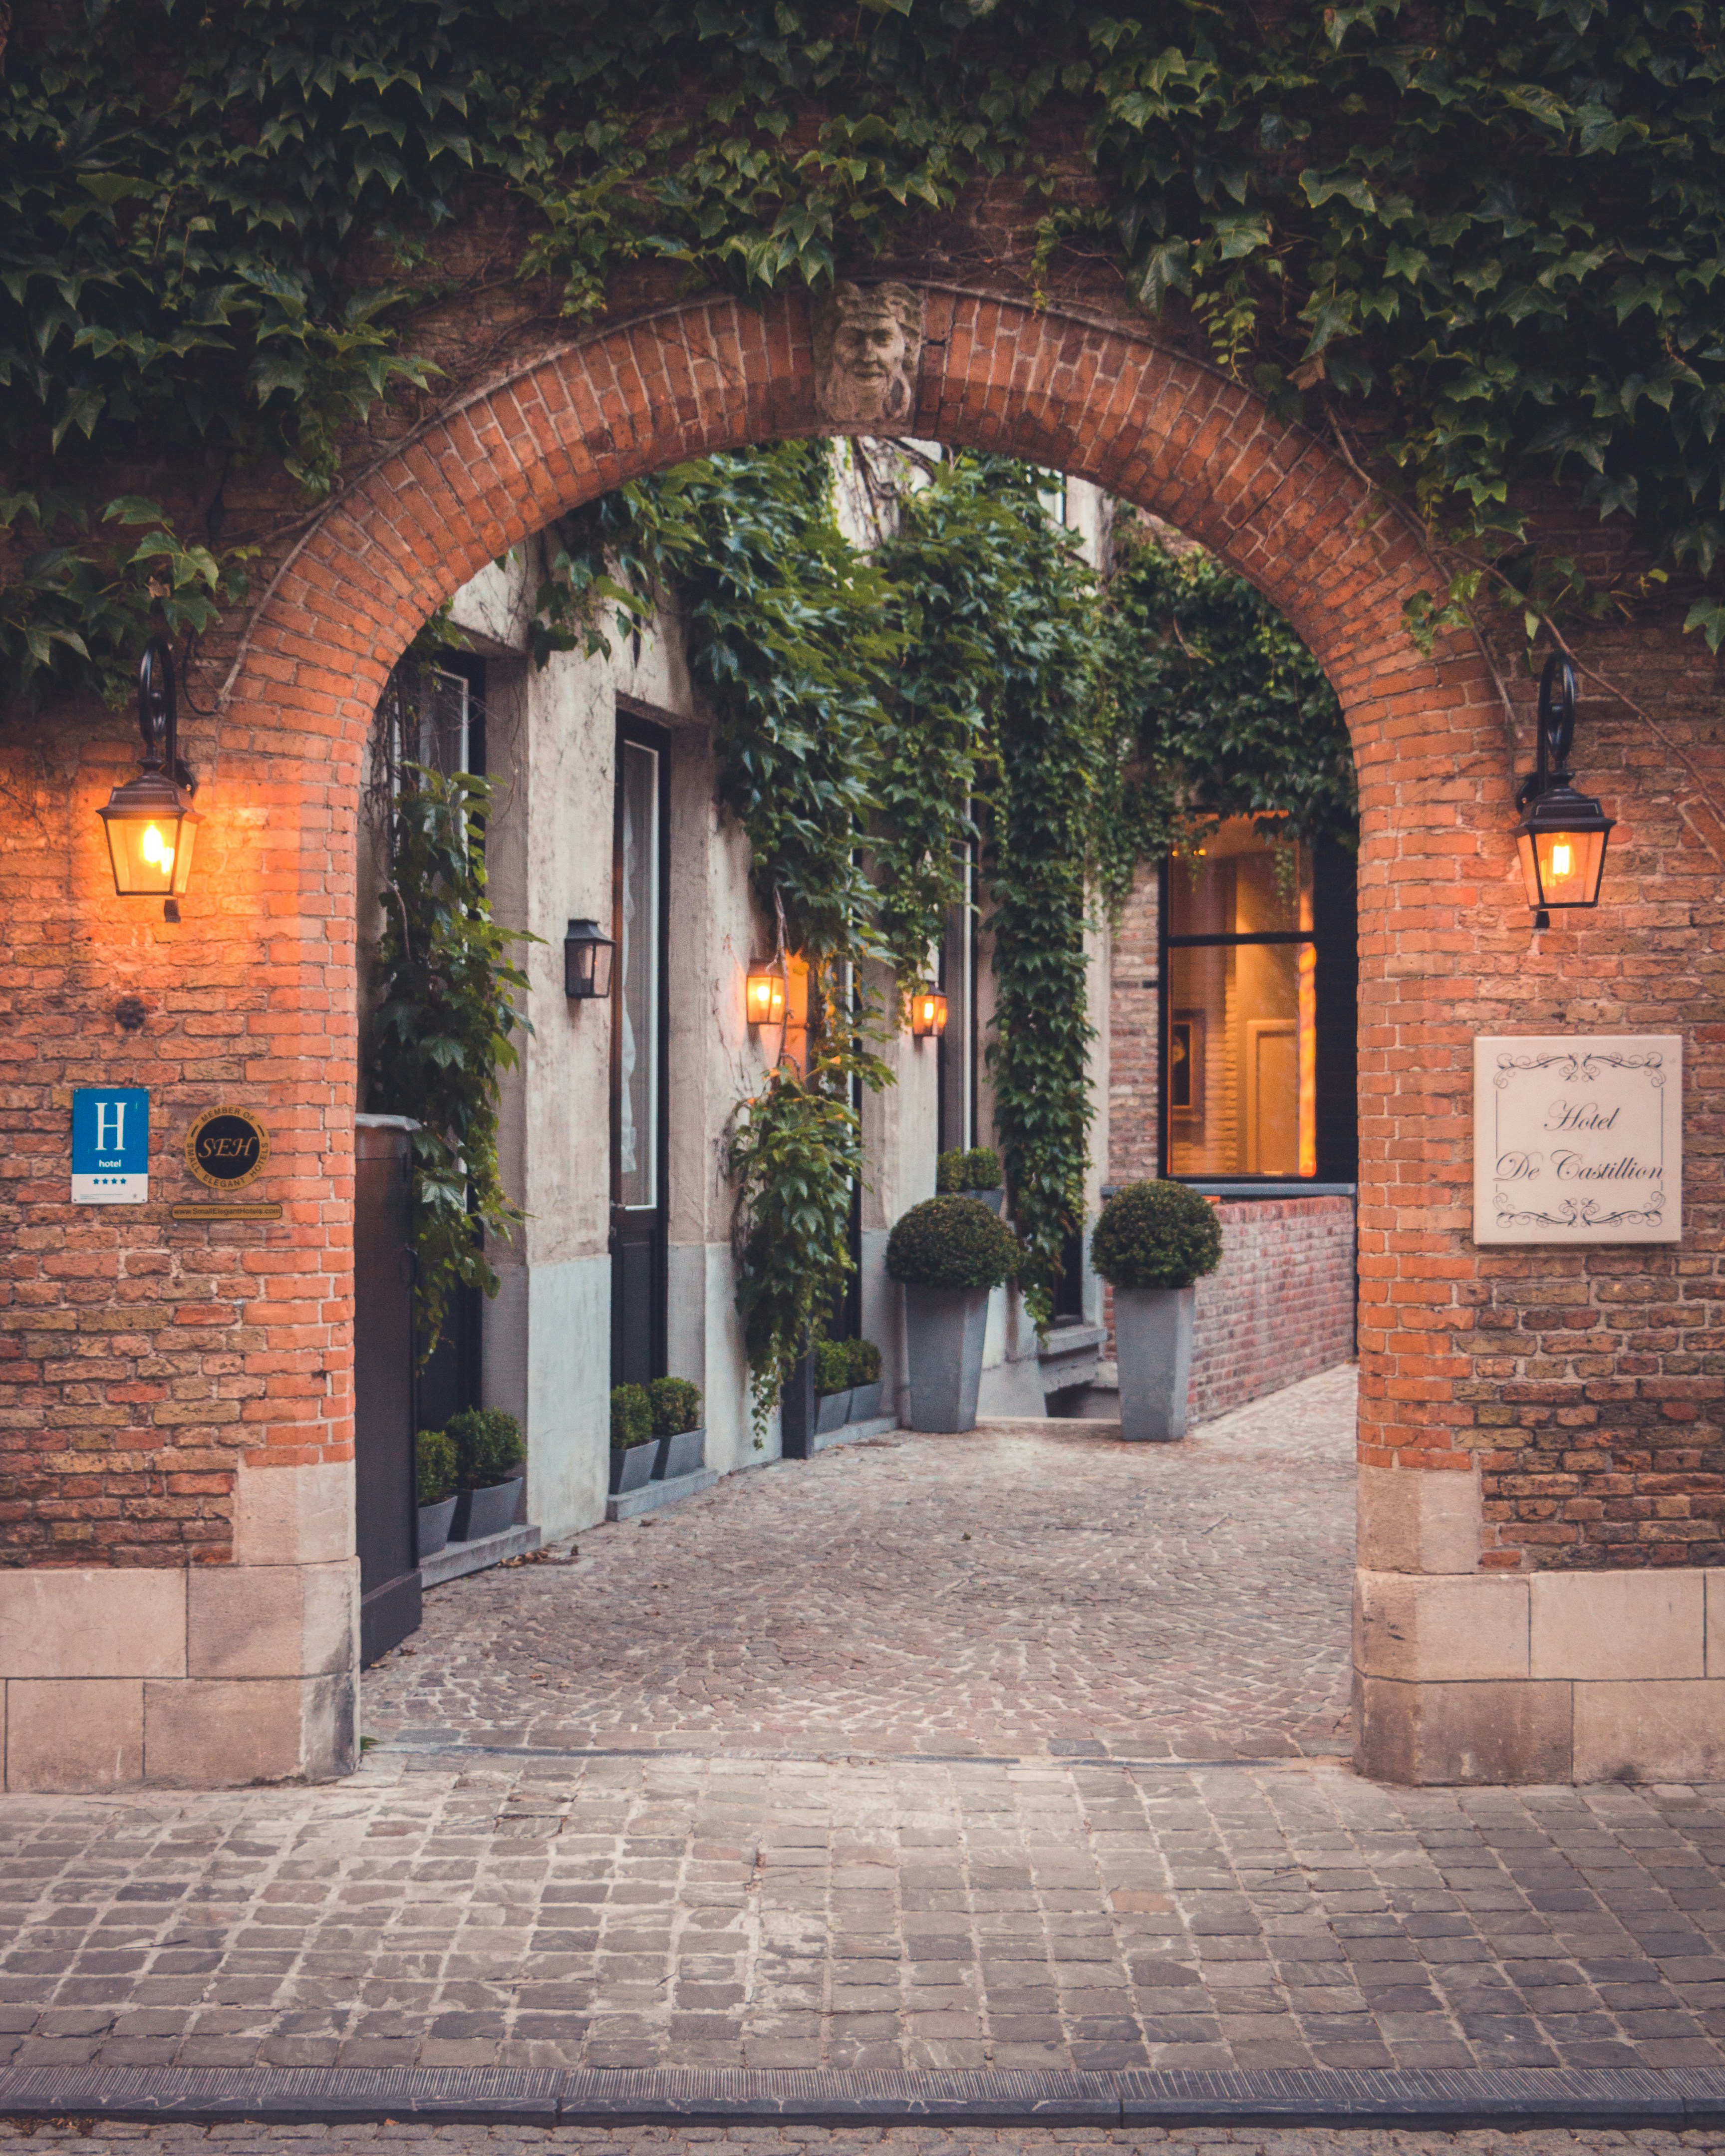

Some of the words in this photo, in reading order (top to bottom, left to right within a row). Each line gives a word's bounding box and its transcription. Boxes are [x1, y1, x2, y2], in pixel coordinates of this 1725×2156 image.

[95, 1102, 127, 1150] H
[201, 1106, 241, 1122] MEMBER
[243, 1111, 255, 1121] OF
[1543, 1099, 1621, 1131] Hotel
[198, 1136, 257, 1158] SEH
[99, 1159, 122, 1168] hotel
[187, 1142, 200, 1173] SMALL
[203, 1173, 246, 1188] ELEGANT
[249, 1142, 269, 1178] HOTELS
[1492, 1151, 1544, 1181] De
[1550, 1149, 1663, 1181] Castillion
